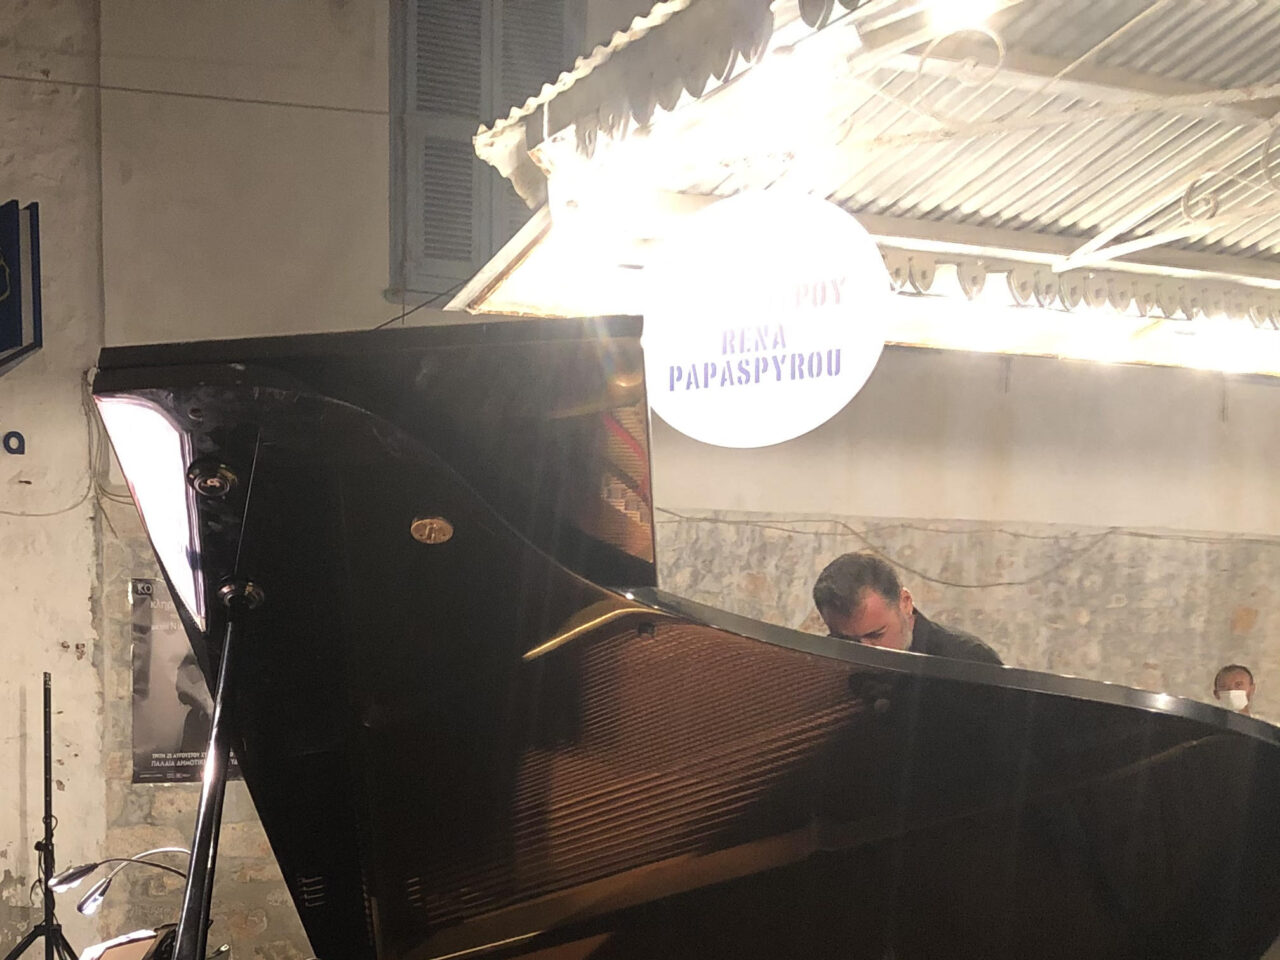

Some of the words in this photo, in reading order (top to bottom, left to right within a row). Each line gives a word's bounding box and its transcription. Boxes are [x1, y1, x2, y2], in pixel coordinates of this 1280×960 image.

[722, 323, 787, 356] RENA
[668, 348, 842, 392] PAPASPYROU
[176, 758, 206, 767] ΔΗΜΟΤΙΚ
